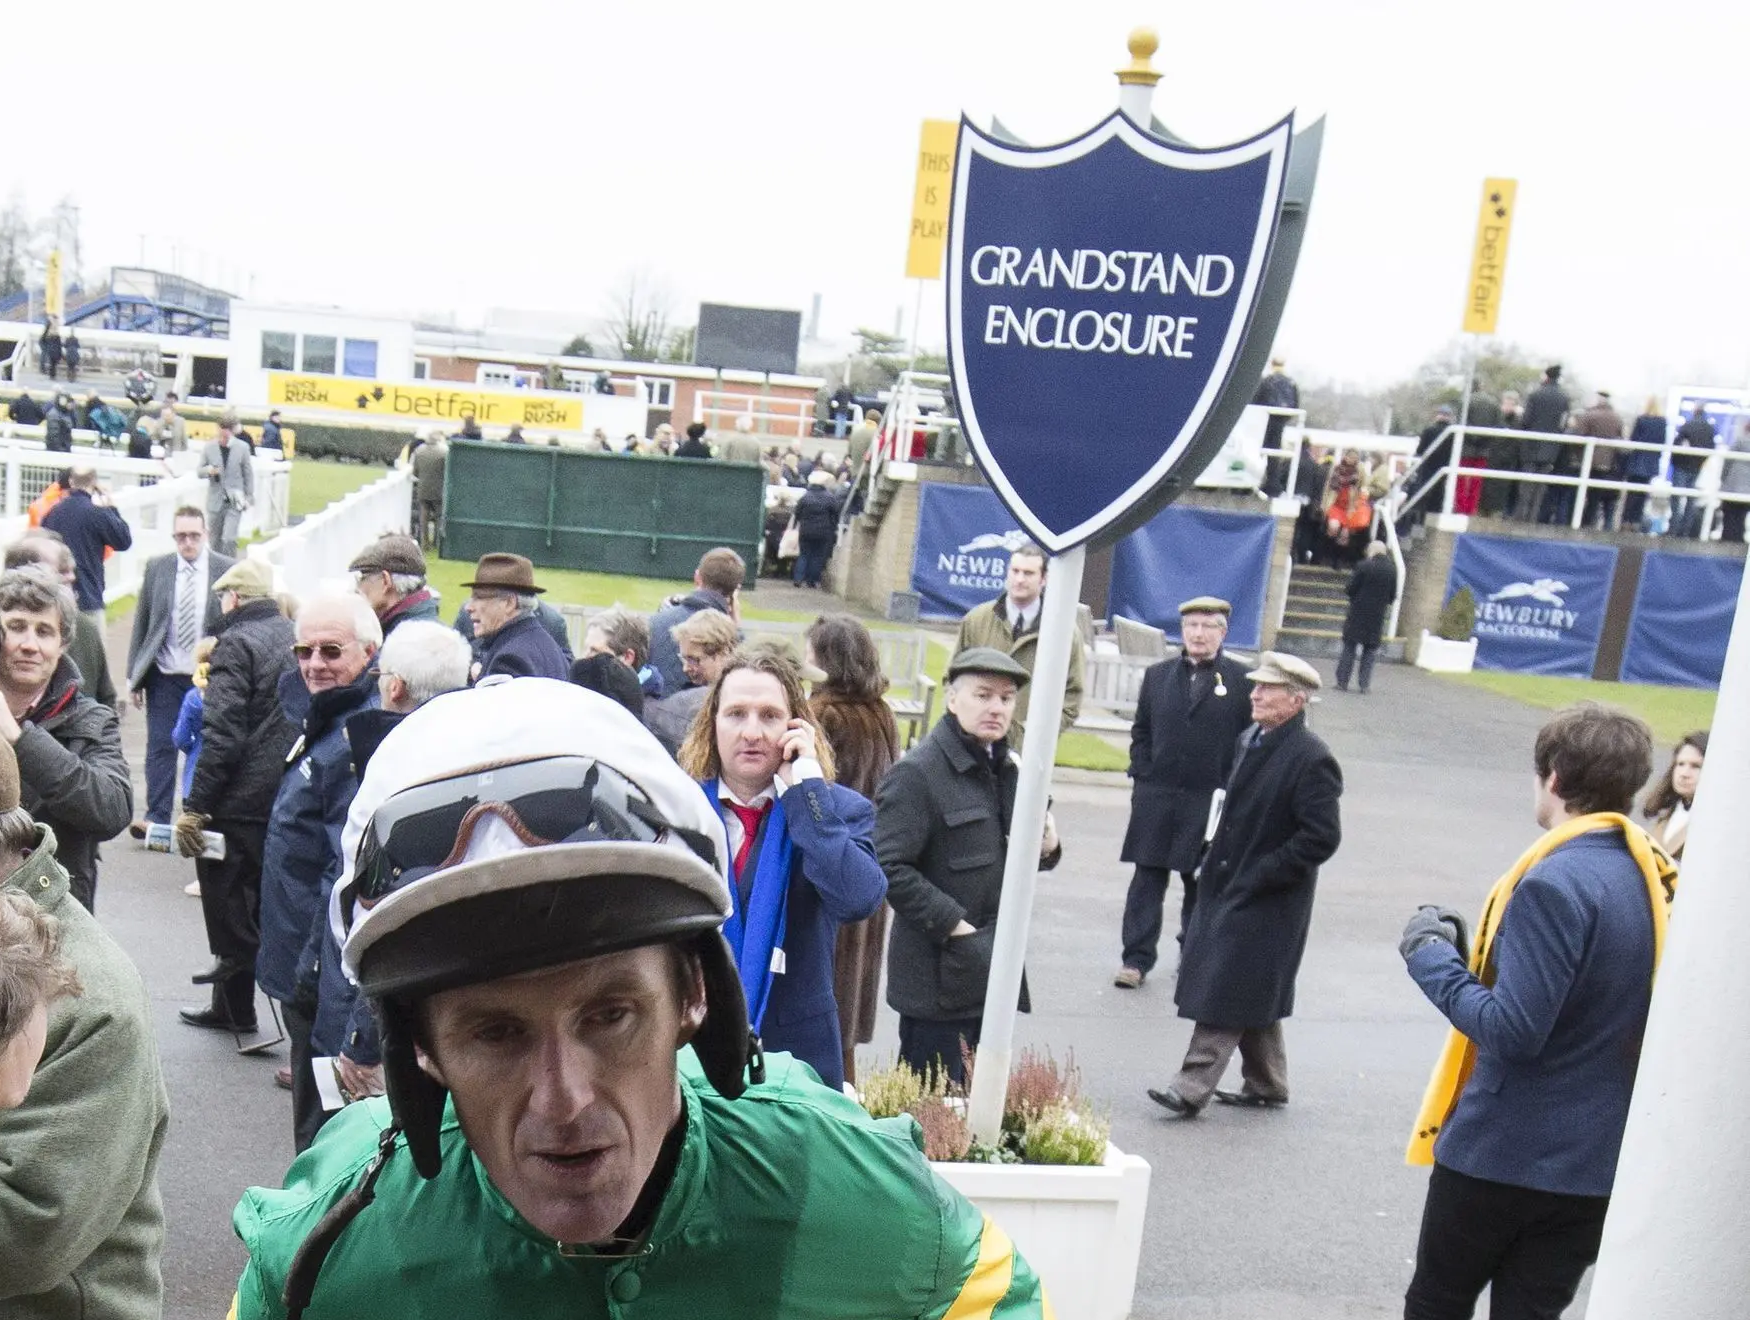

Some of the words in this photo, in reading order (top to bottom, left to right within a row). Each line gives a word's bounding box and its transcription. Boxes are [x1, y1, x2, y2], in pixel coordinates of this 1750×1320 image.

[920, 152, 951, 172] THIS
[924, 185, 938, 206] IS
[911, 217, 945, 240] PLAY
[970, 244, 1235, 298] GRANDSTAND
[1473, 225, 1504, 322] betfair
[984, 304, 1199, 359] ENCLOSURE
[284, 389, 329, 403] RUSH
[394, 388, 499, 421] betfair
[522, 410, 568, 424] RUSH
[936, 551, 1005, 577] NEWB
[949, 574, 1004, 590] RACECO
[1474, 600, 1580, 630] NEWBURY
